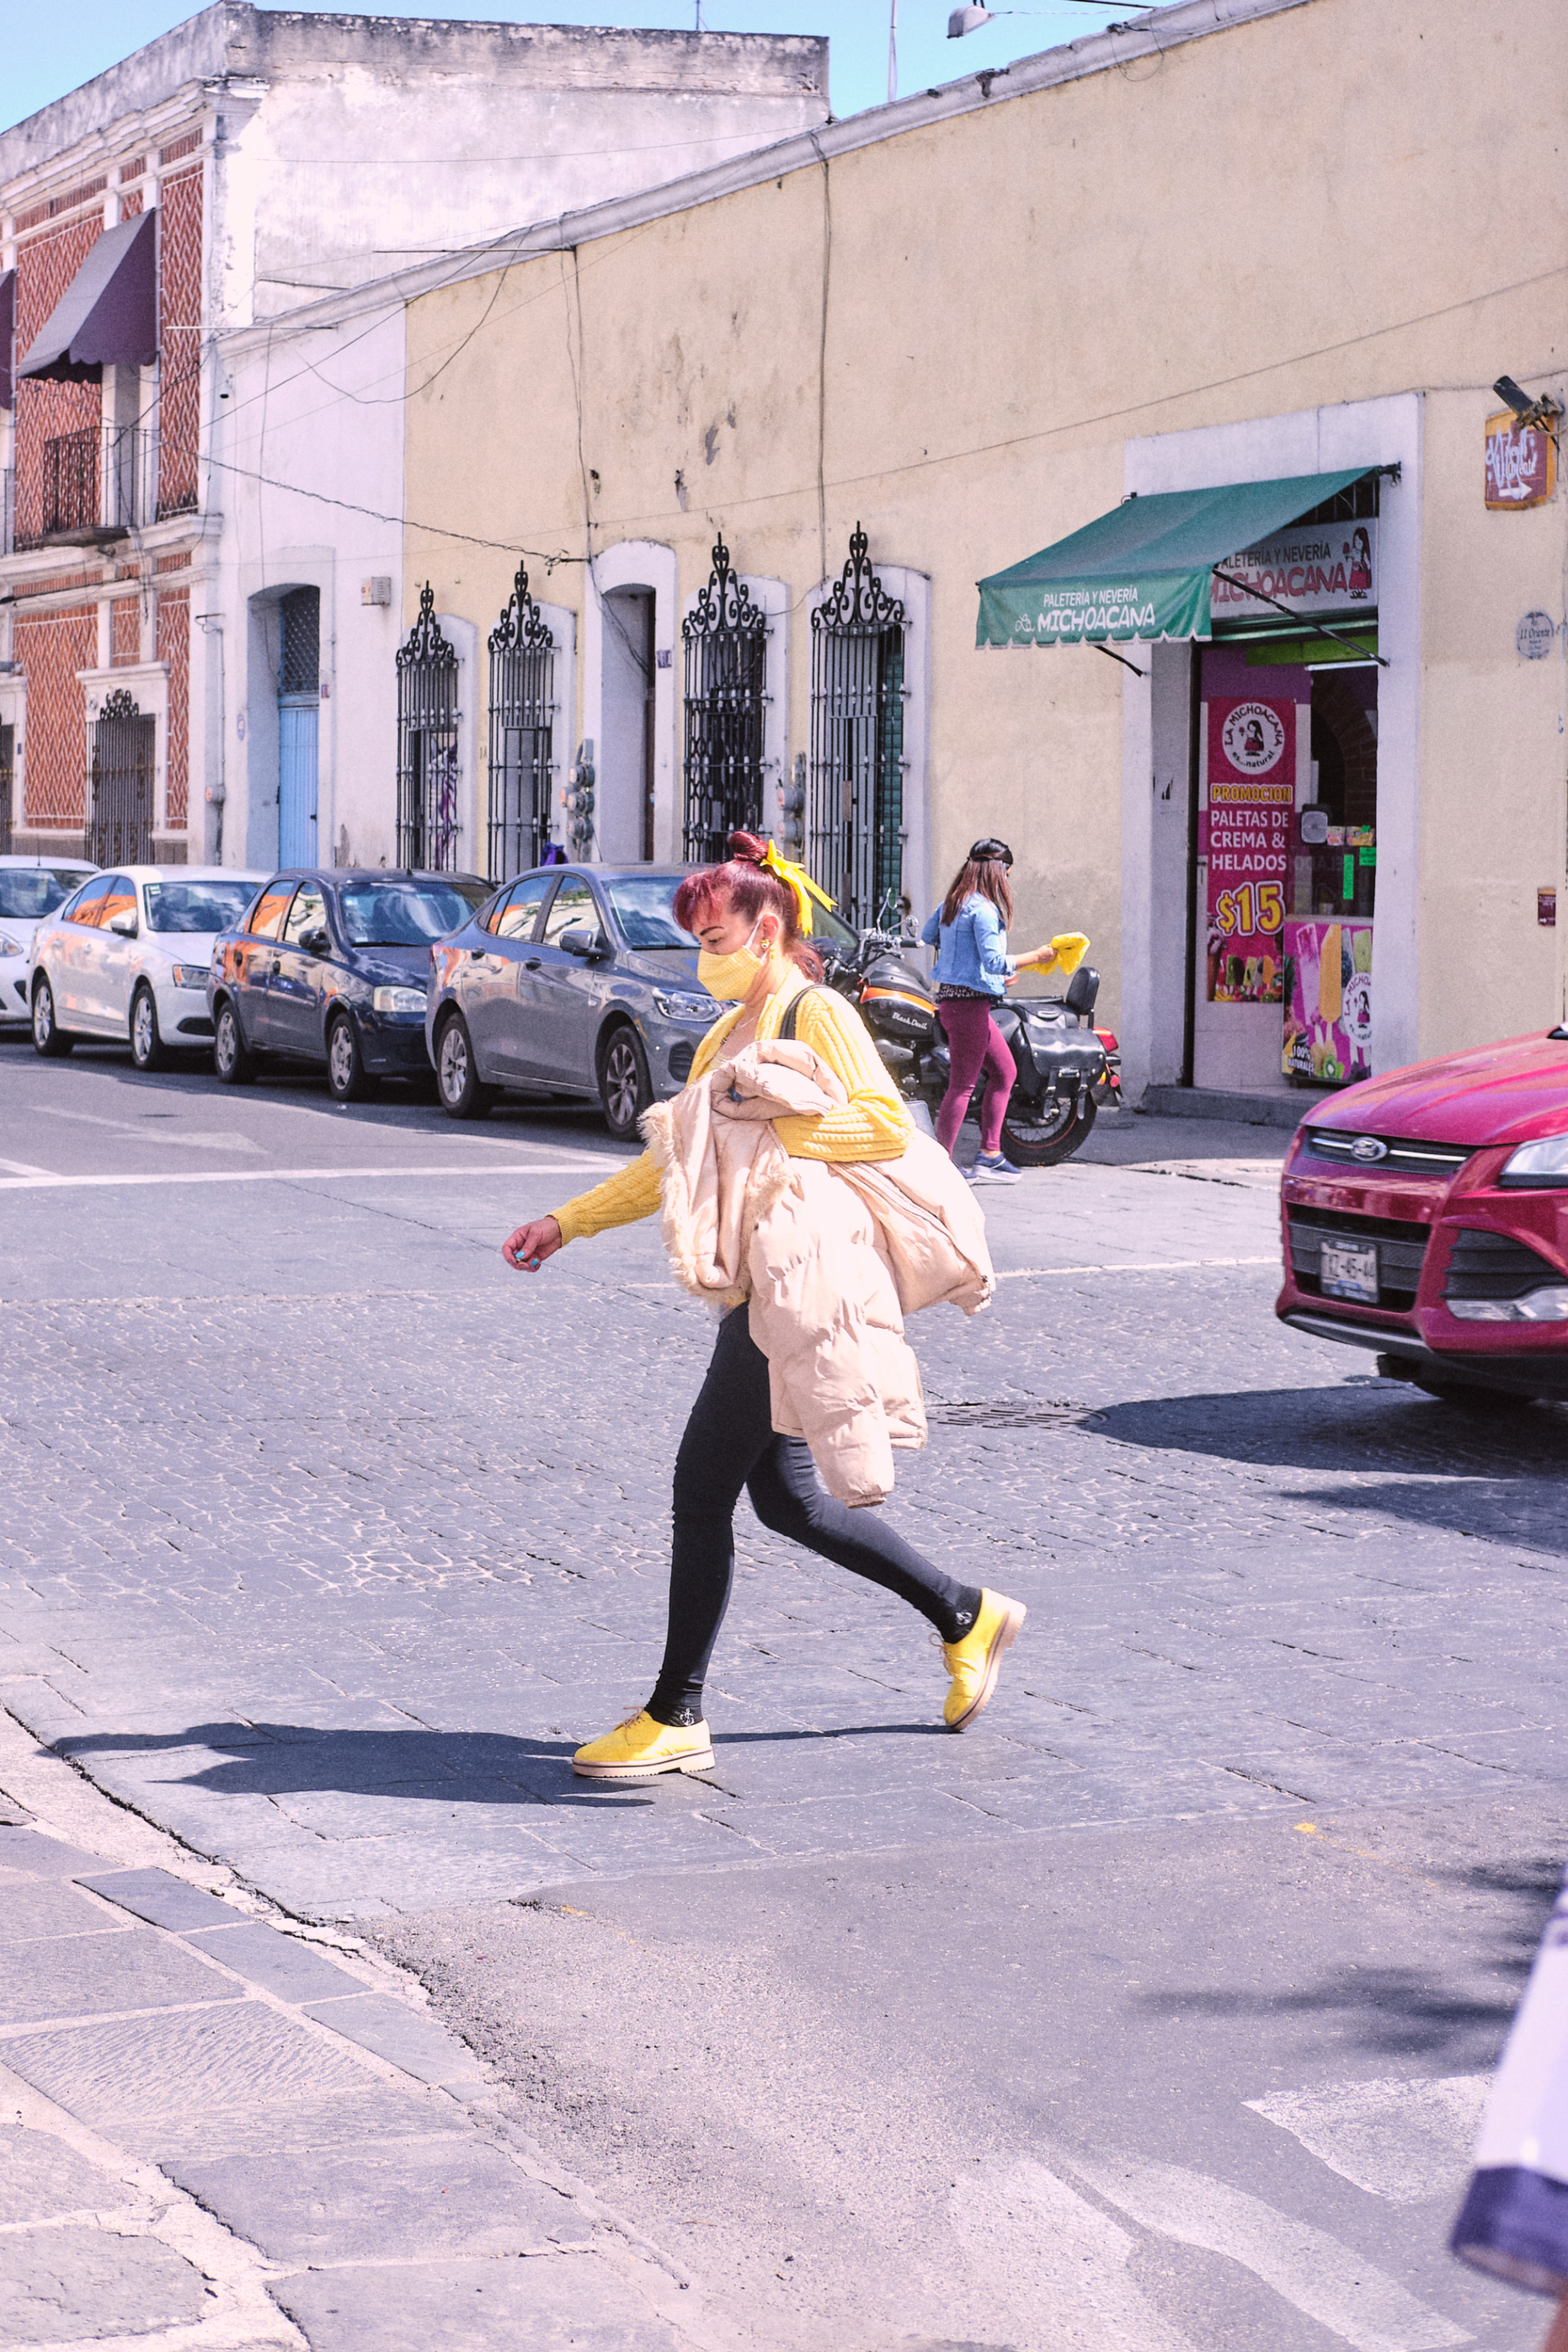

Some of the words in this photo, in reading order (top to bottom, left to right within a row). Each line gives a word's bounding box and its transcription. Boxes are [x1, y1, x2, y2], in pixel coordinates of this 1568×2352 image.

[1214, 546, 1272, 570] ALETERÍA
[1274, 548, 1282, 564] Y
[1283, 540, 1331, 564] NEVERÍA
[1044, 589, 1091, 608] PALETERÍA
[1092, 590, 1098, 605] Y
[1099, 585, 1138, 604] NEVERÍA
[1037, 602, 1156, 633] MICHOACANA
[1229, 705, 1283, 746] MICHOACANA
[1225, 728, 1234, 746] LA
[1211, 785, 1292, 803] PROMOCION
[1210, 810, 1268, 827] PALETAS
[1272, 811, 1289, 828] DE
[1210, 831, 1267, 848] CREMA
[1271, 832, 1286, 848] &
[1211, 854, 1287, 871] HELADOS
[1218, 884, 1283, 934] $15
